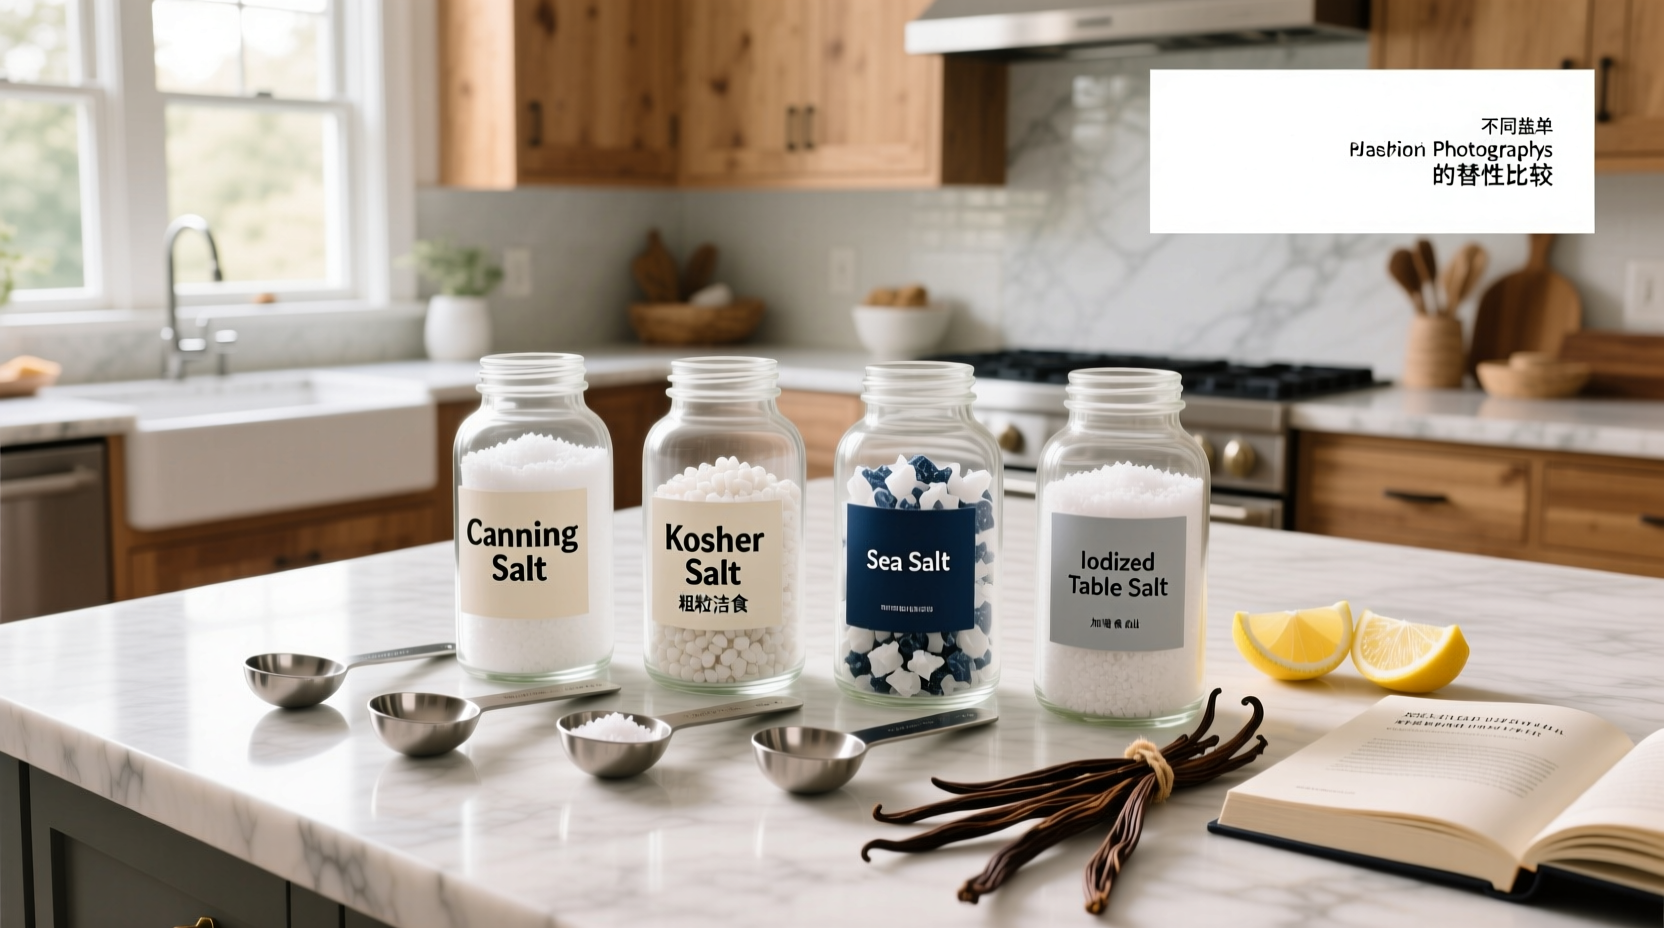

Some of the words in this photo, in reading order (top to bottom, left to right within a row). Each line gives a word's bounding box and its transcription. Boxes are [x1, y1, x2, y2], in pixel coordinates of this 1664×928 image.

[466, 517, 579, 554] Canning
[665, 523, 765, 553] Kosher
[492, 553, 548, 582] Salt
[685, 557, 742, 586] Salt
[866, 549, 903, 572] Sea
[908, 550, 951, 572] Salt
[1081, 550, 1155, 572] Iodized
[1067, 574, 1123, 598] Table
[1128, 576, 1169, 598] Salt
